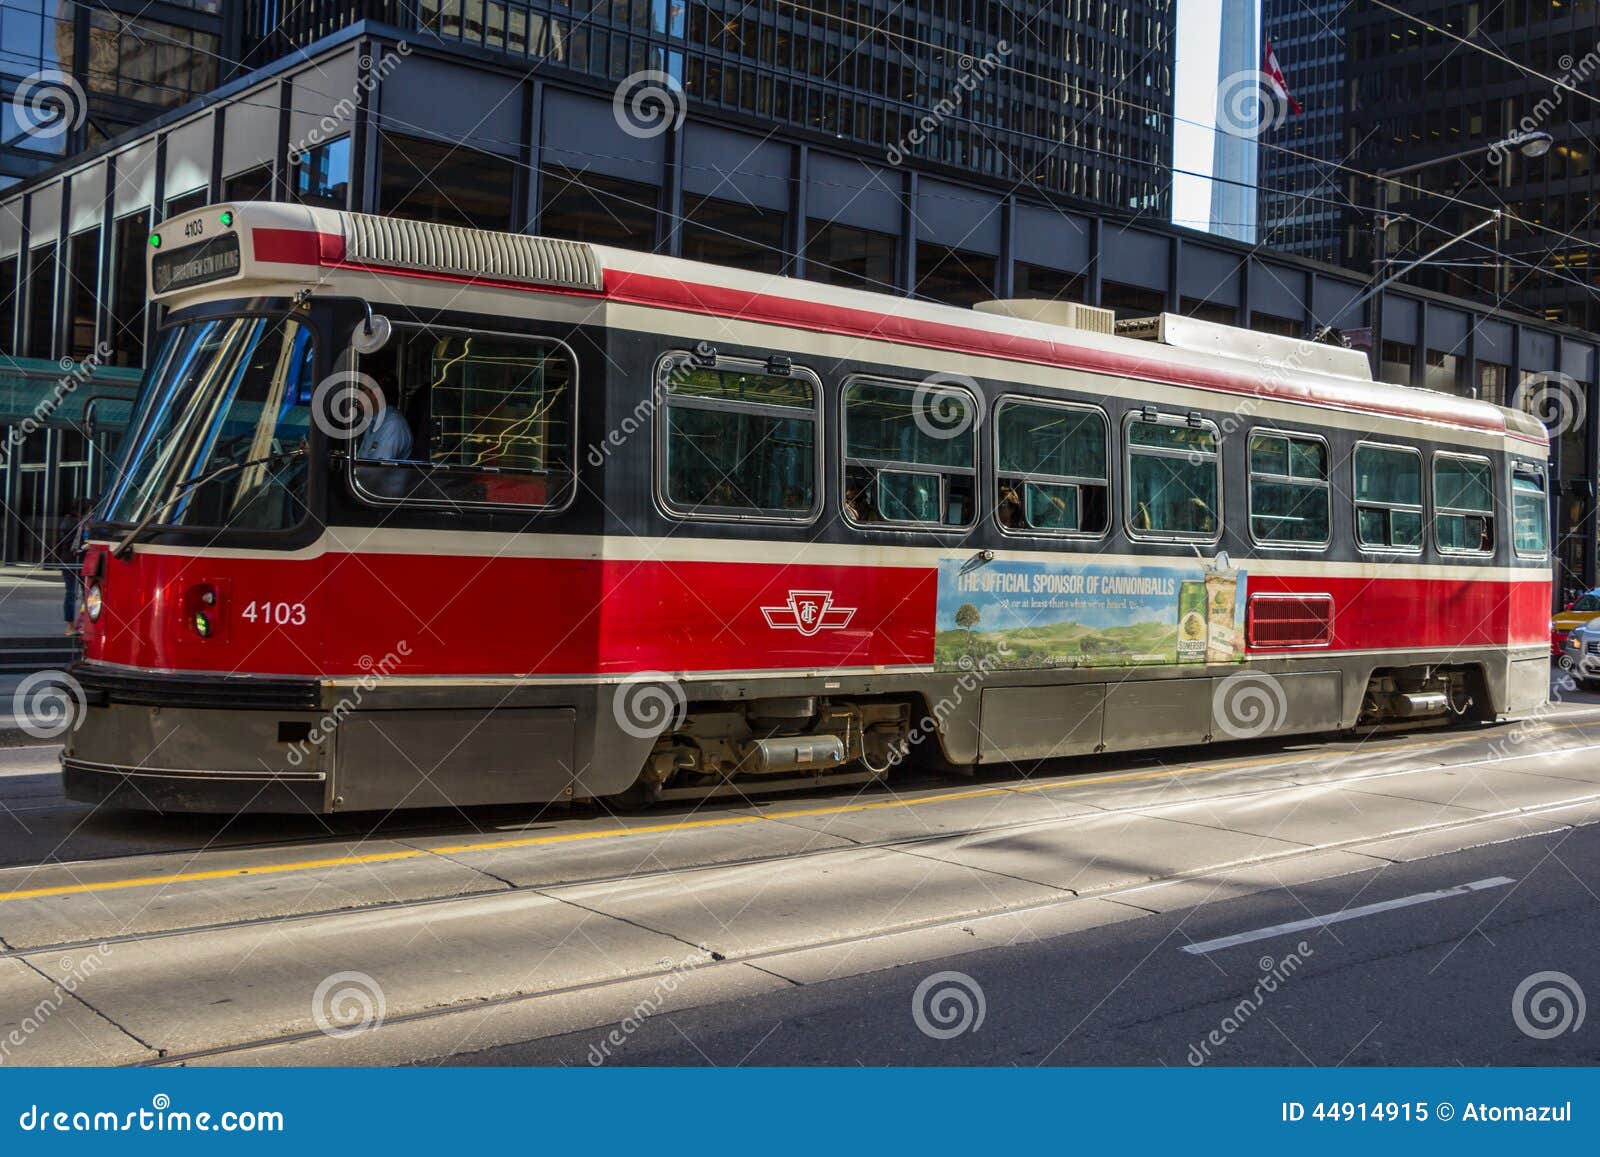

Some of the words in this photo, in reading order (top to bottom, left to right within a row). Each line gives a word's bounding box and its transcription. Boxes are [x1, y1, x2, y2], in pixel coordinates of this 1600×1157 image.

[185, 219, 203, 238] 4103
[957, 572, 979, 592] THE
[981, 573, 1030, 593] OFFICIAL
[1033, 574, 1084, 594] SPONSOR
[1086, 576, 1100, 594] OF
[1101, 576, 1175, 595] CANNONBALLS
[242, 601, 306, 625] 4103
